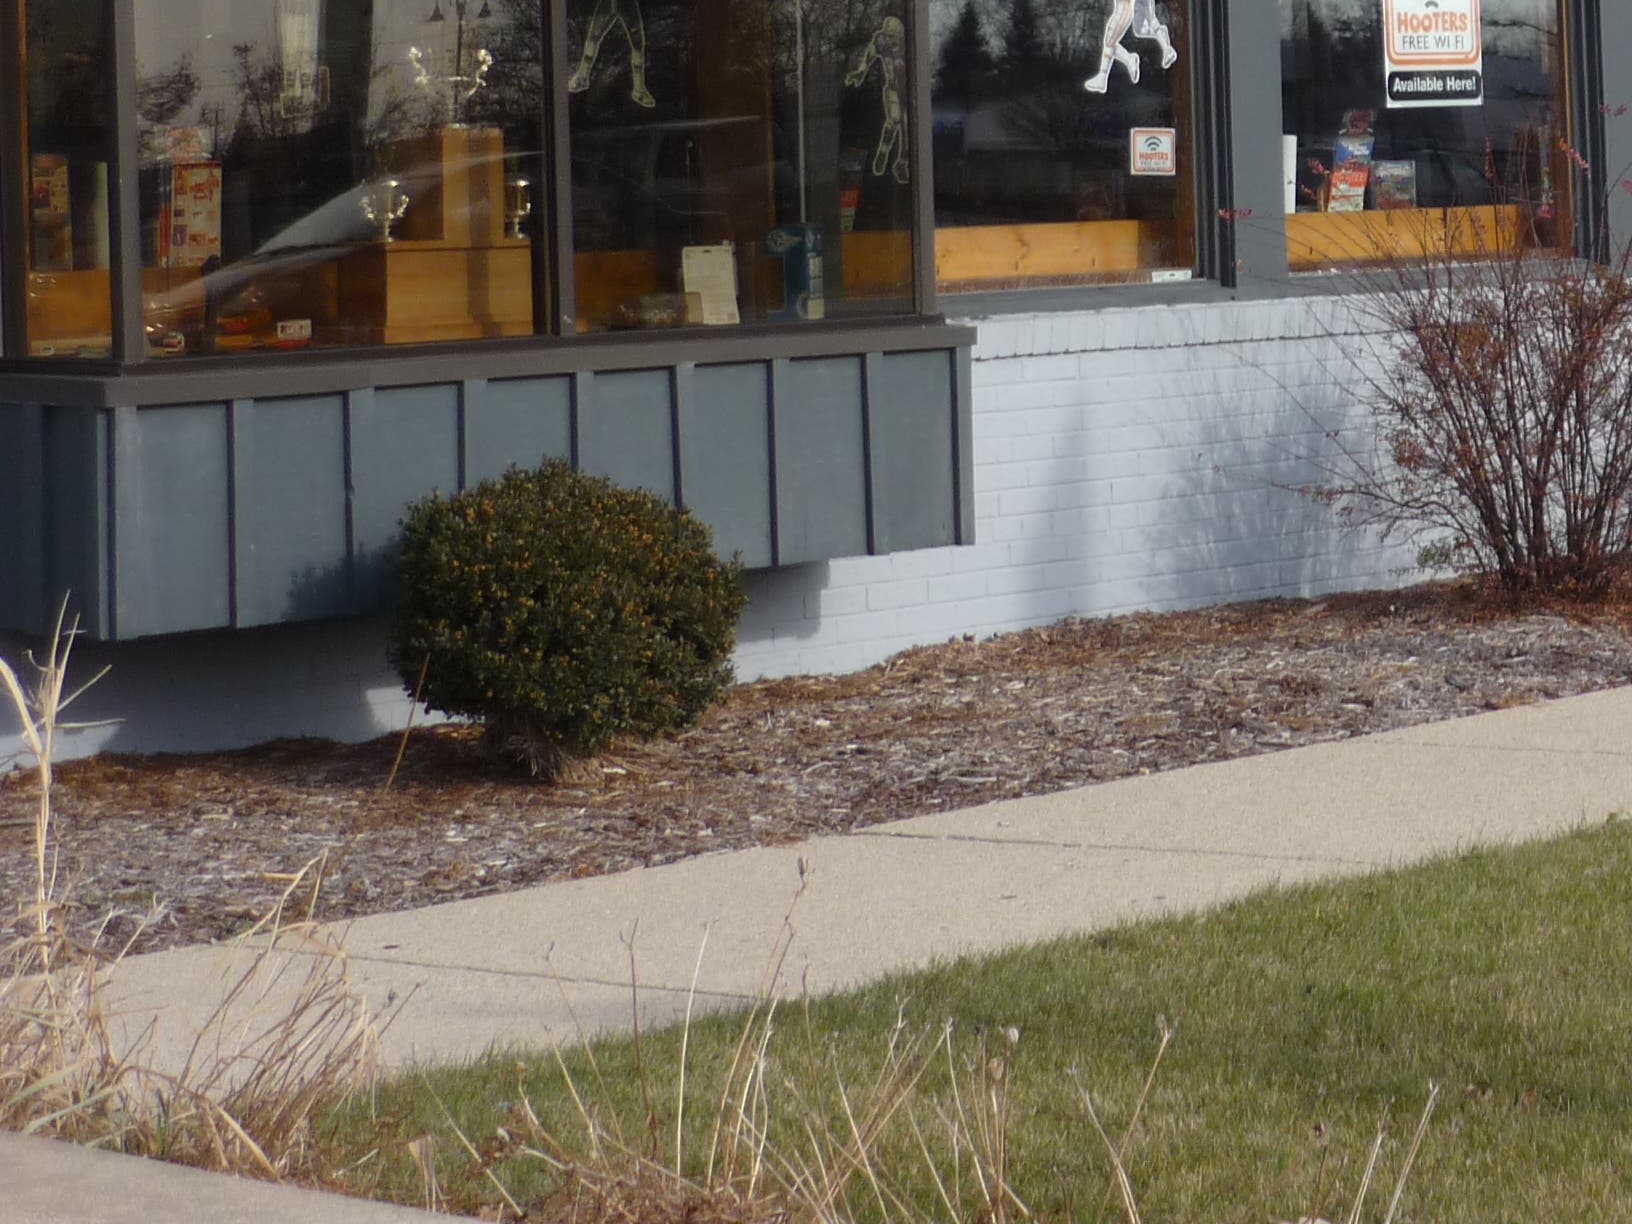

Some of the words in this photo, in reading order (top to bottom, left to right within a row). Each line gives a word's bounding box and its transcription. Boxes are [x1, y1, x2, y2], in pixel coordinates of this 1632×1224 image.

[1397, 11, 1468, 33] HOOTERS
[1402, 35, 1429, 49] FREE
[1435, 35, 1450, 49] WI
[1455, 35, 1465, 49] FI
[1393, 77, 1444, 93] Available
[1446, 76, 1476, 92] Here!
[1139, 151, 1169, 161] HOOTERS
